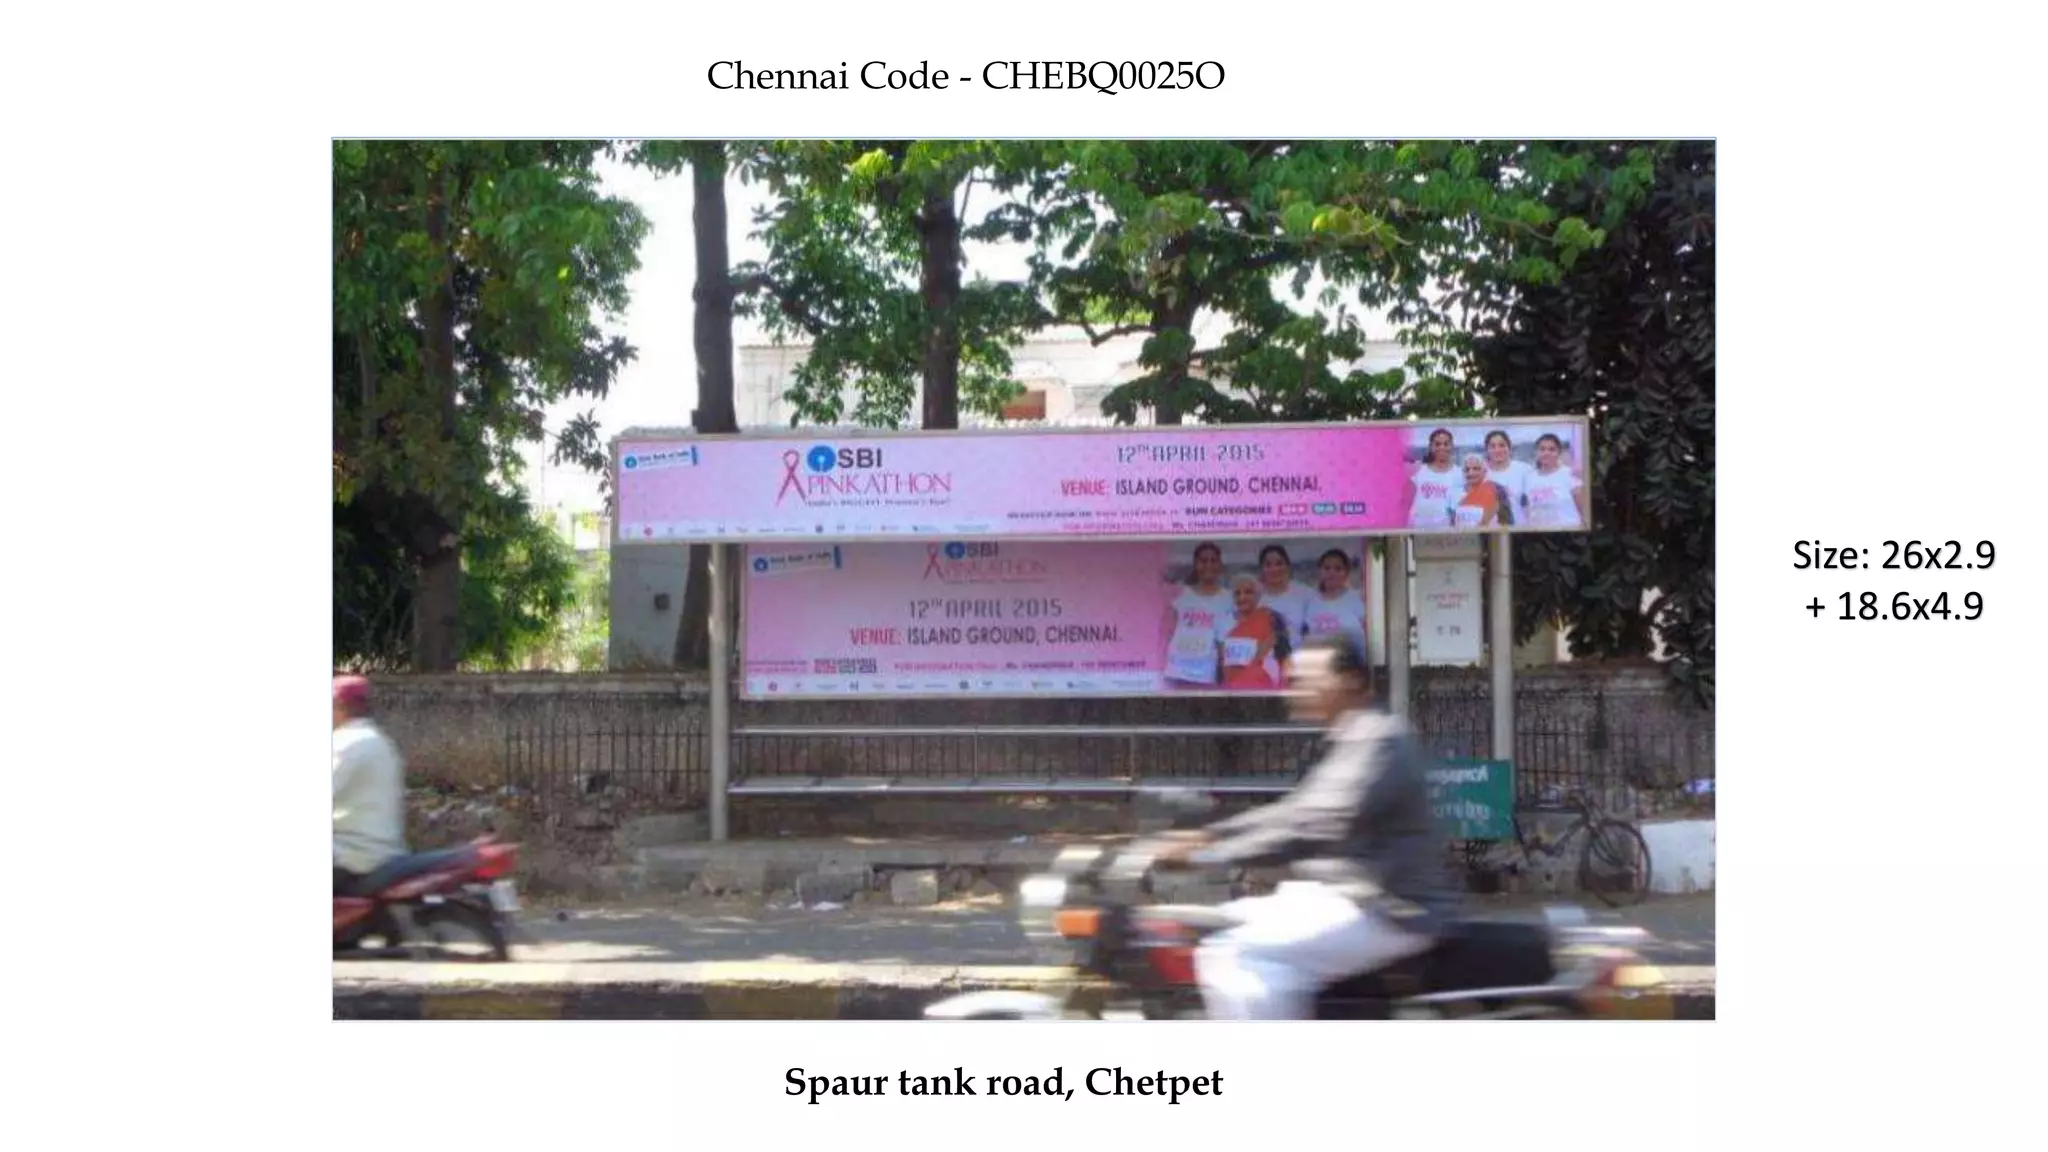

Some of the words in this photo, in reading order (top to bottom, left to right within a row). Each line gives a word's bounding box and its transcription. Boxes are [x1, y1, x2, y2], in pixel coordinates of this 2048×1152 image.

[837, 447, 884, 469] SBI
[1153, 444, 1206, 463] APRIL
[1217, 443, 1265, 462] 2015
[807, 471, 953, 496] PINKATHON
[1115, 478, 1168, 496] ISLAND
[945, 598, 1003, 618] APRIL
[1012, 598, 1063, 618] 2015
[907, 626, 962, 645] ISLAND
